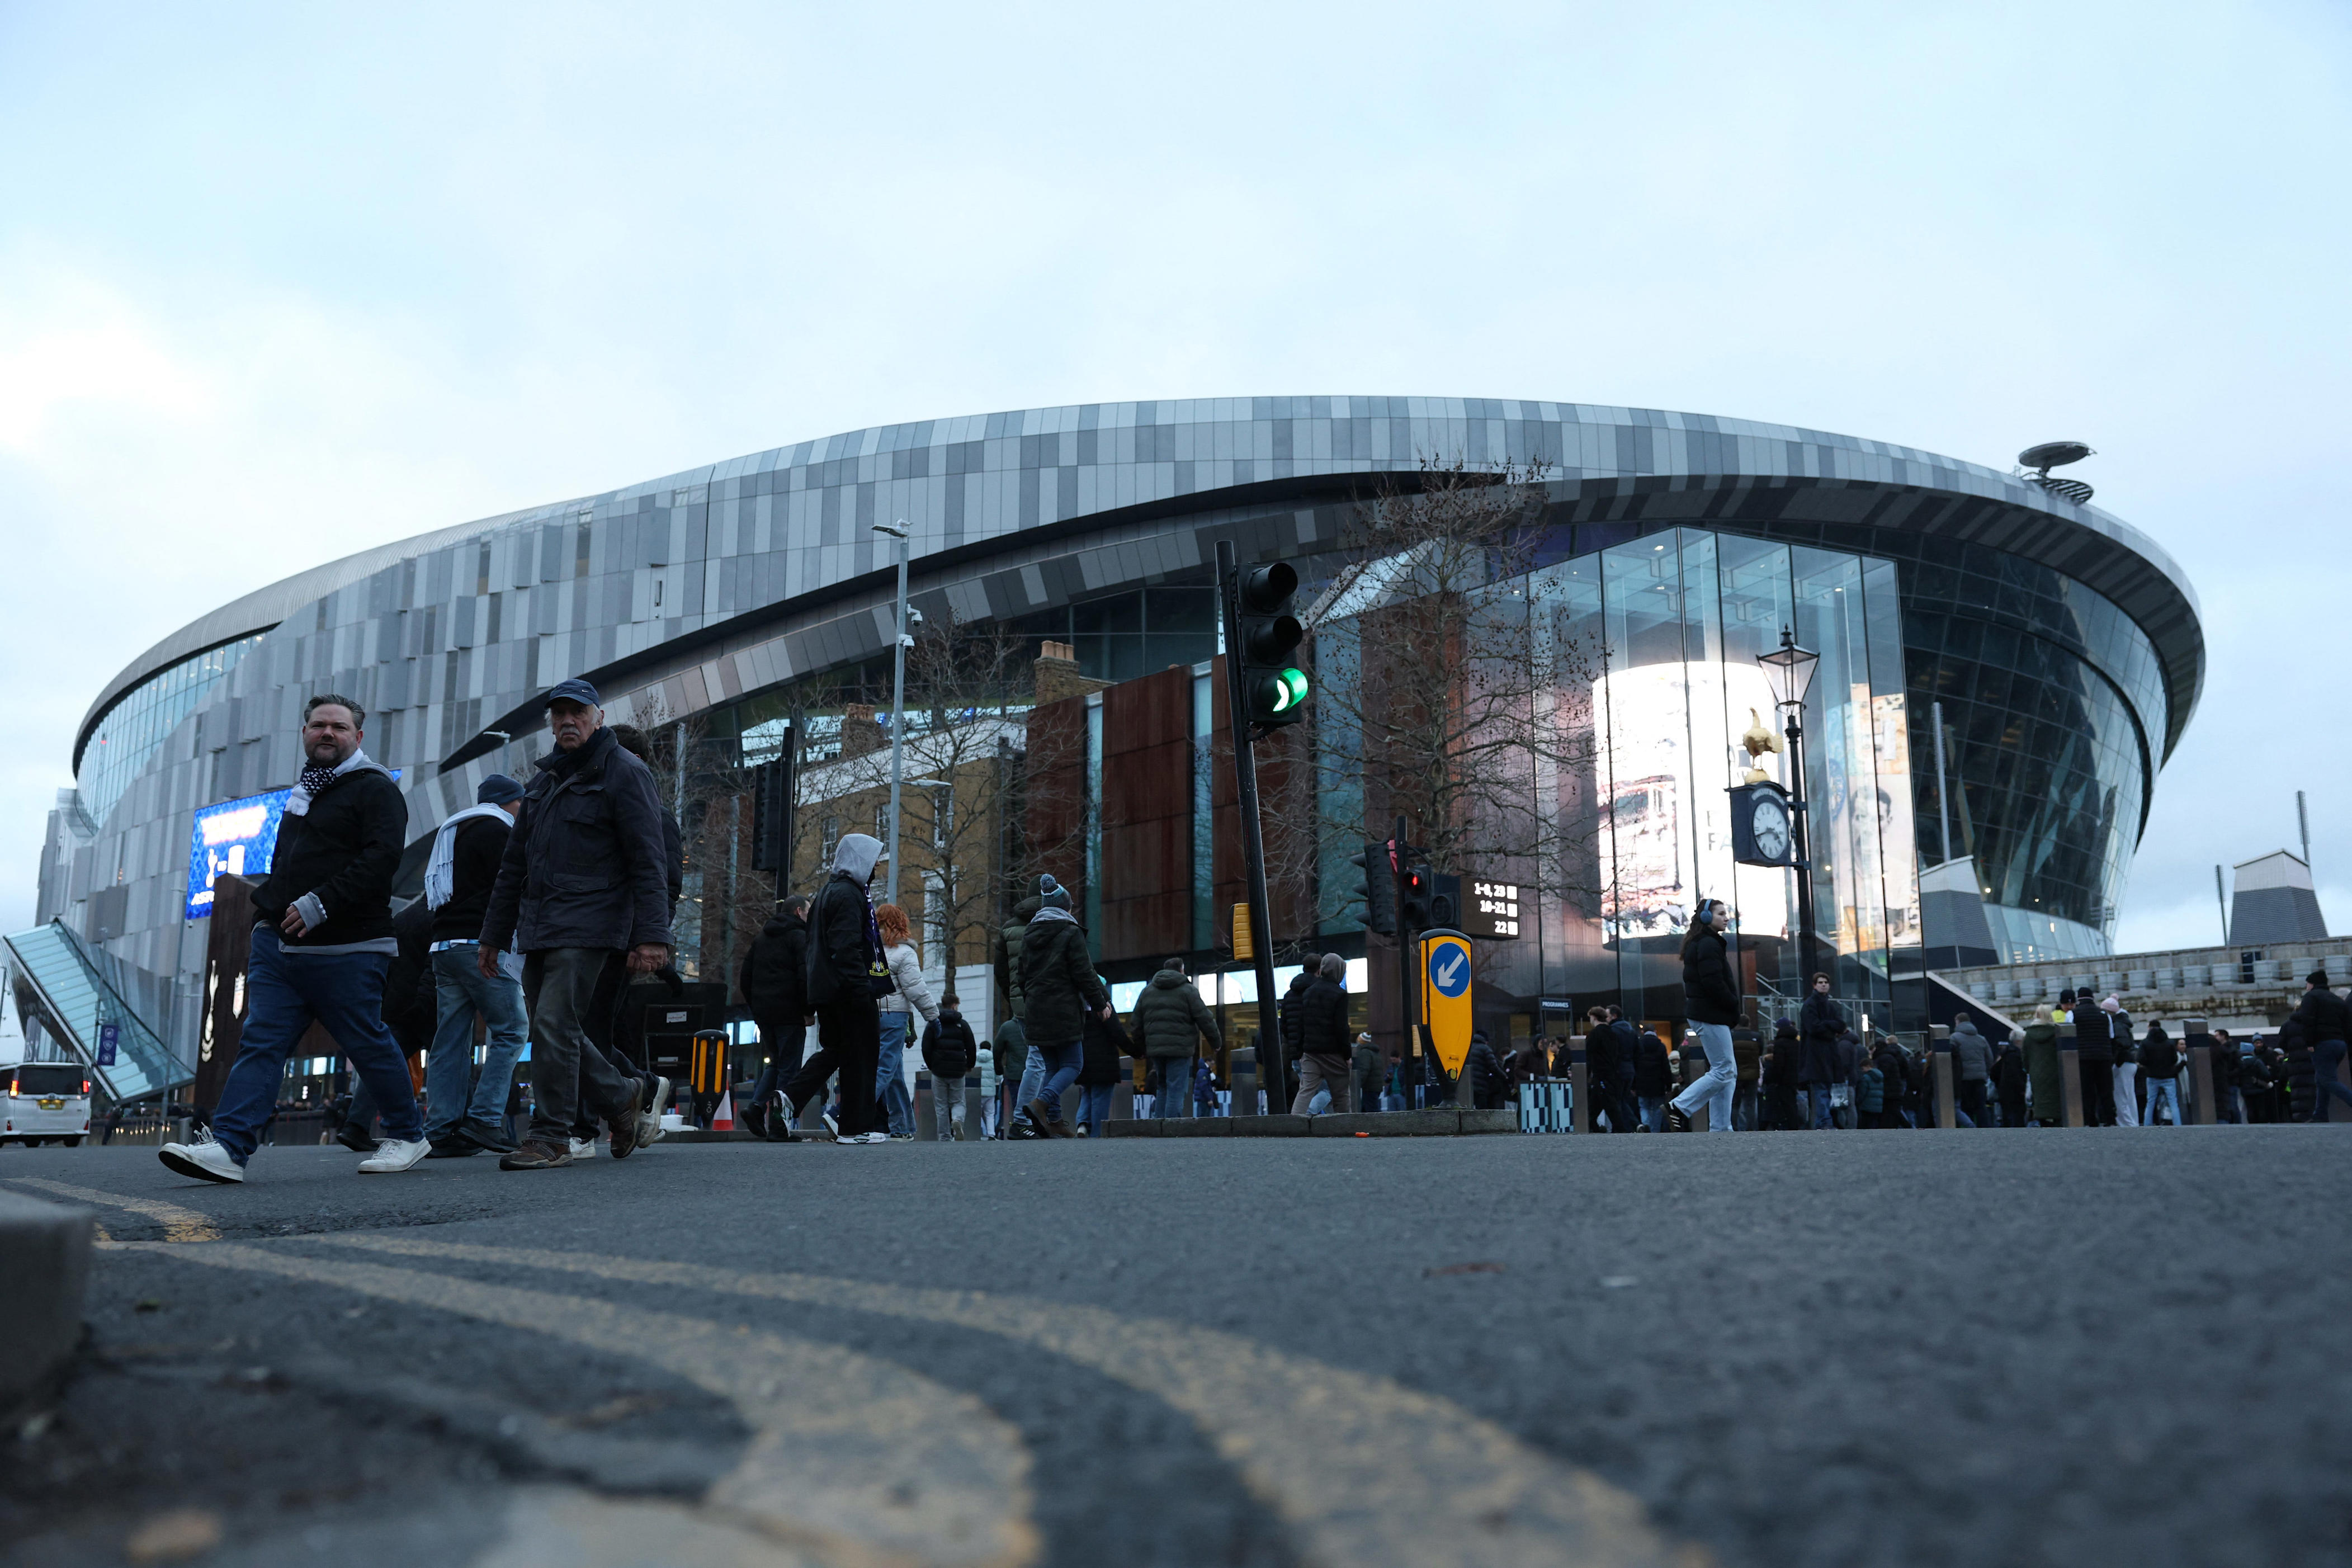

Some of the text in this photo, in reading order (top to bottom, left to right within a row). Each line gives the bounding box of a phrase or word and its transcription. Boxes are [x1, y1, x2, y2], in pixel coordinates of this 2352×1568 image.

[1494, 885, 1506, 897] 23
[1480, 900, 1506, 914] 10-21
[1495, 920, 1507, 934] 22
